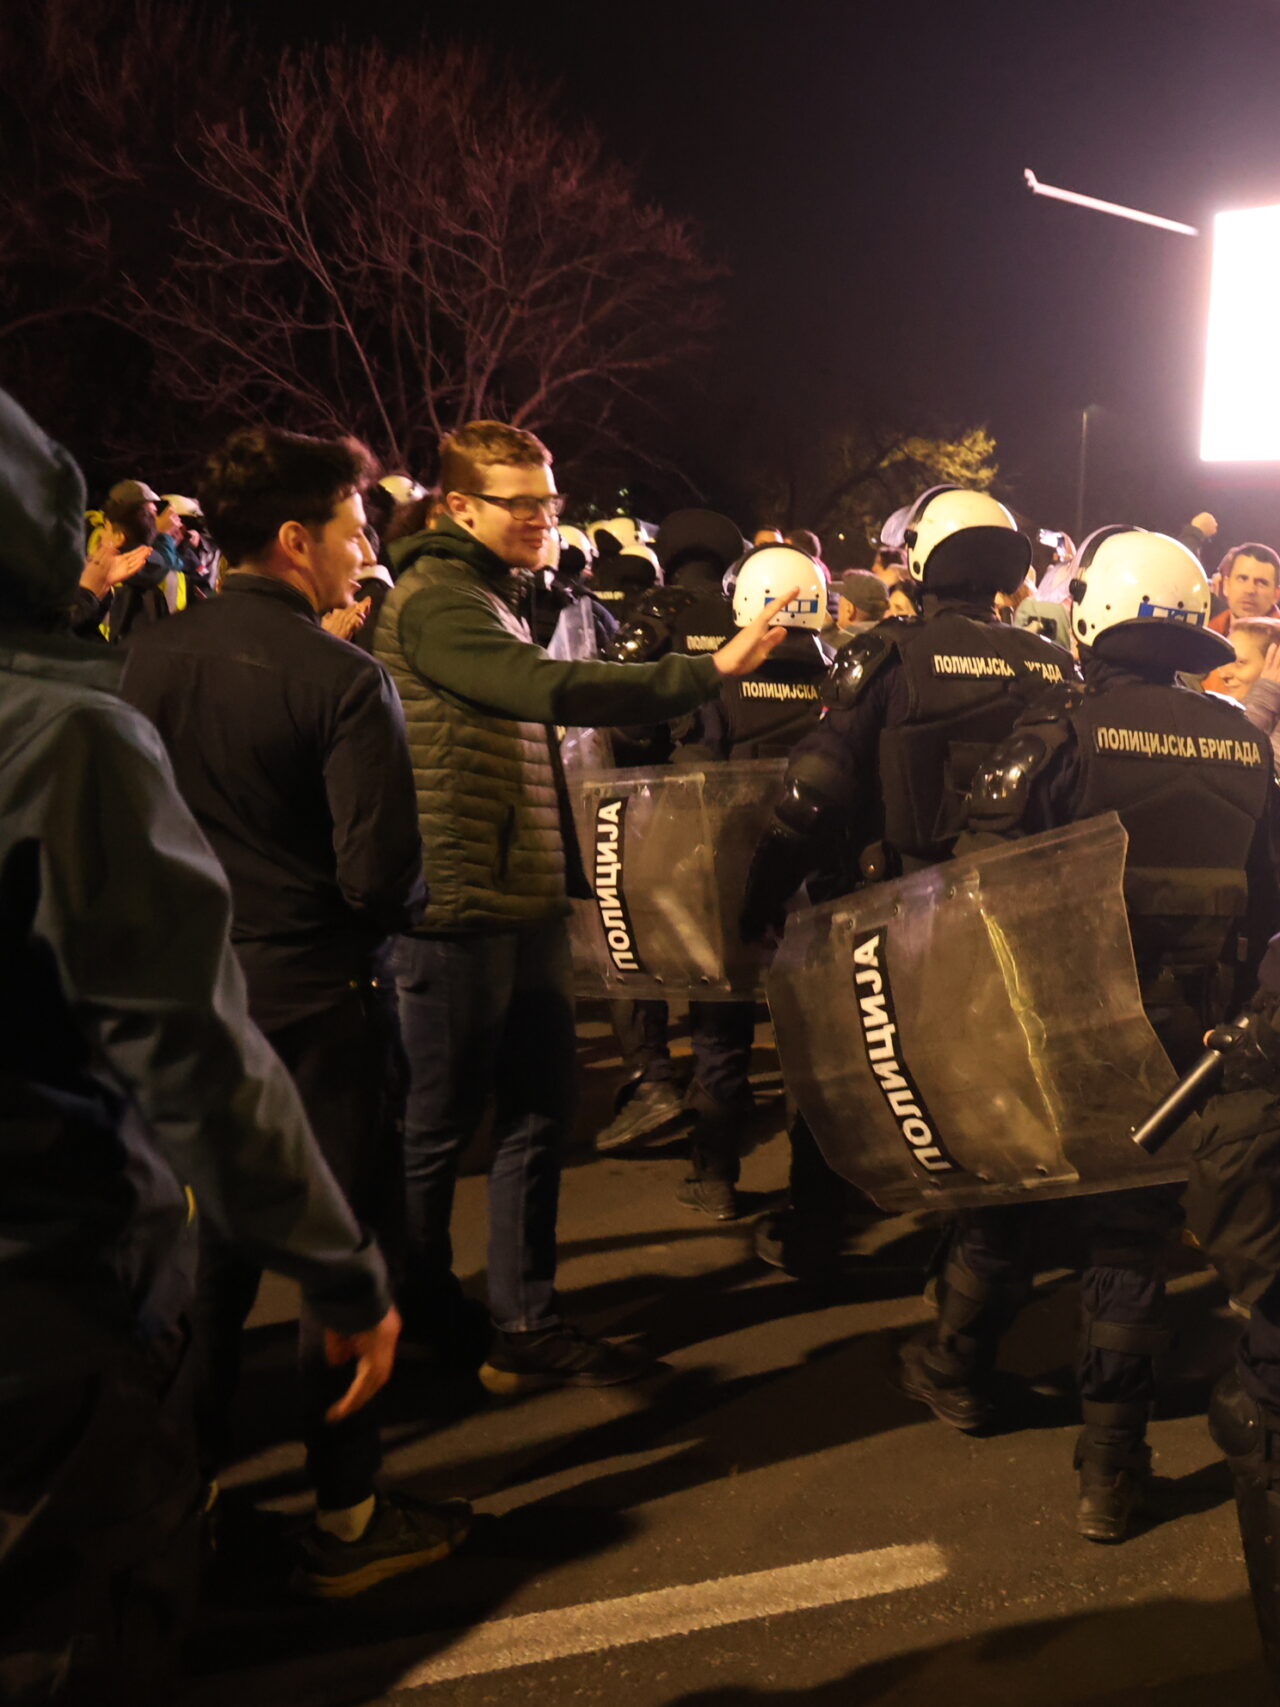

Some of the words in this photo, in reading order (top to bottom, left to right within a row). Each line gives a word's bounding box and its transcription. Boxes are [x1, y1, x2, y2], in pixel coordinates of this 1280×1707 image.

[741, 681, 819, 701] ПОЛИЦИЈСКА
[1097, 727, 1198, 758] ПОЛИЦИЈСКА
[1198, 737, 1262, 767] БРИГАДА
[595, 800, 640, 971] ПОЛИЦИЈА
[853, 934, 953, 1172] ПОЛИЦИЈА
